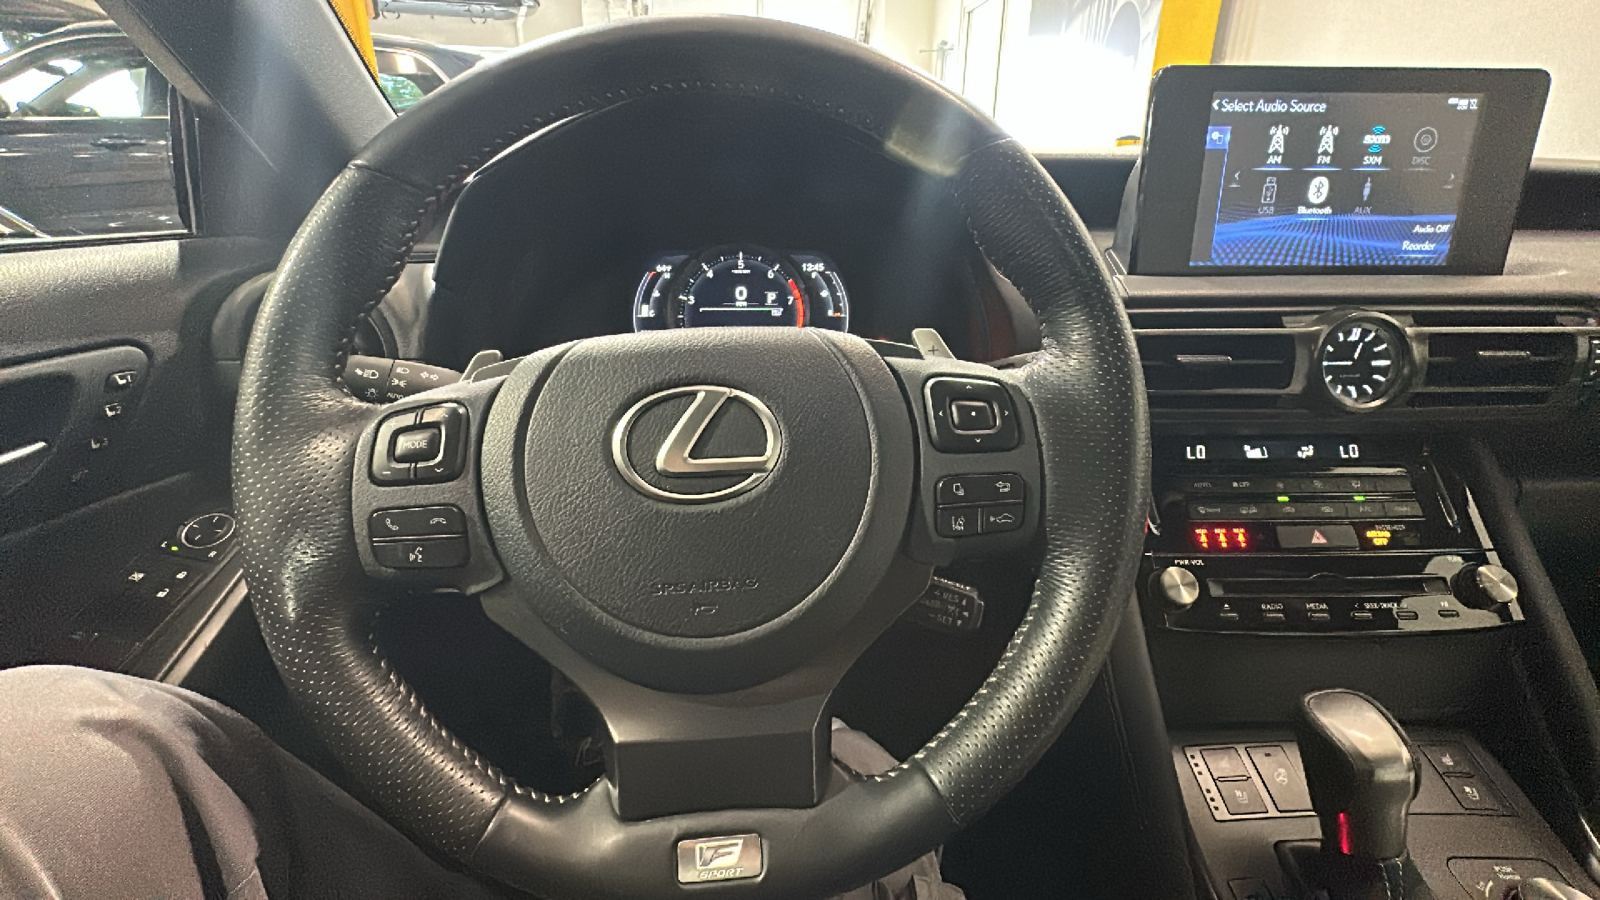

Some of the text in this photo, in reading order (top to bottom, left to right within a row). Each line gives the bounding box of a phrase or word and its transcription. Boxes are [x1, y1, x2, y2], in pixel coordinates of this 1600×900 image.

[1221, 99, 1327, 112] Select Audio Source
[1266, 155, 1282, 164] AM
[1317, 155, 1331, 164] FM
[1363, 155, 1382, 165] SXM
[1412, 156, 1431, 165] DISC
[1258, 206, 1274, 214] USB
[1297, 206, 1332, 214] Bluetooth
[1354, 206, 1372, 214] AUX
[1412, 224, 1434, 233] Audio
[1402, 240, 1436, 250] Reorder
[737, 259, 745, 269] 5
[802, 262, 825, 271] 12:45
[706, 269, 714, 279] 4
[767, 269, 775, 279] 6
[687, 295, 696, 305] 3
[787, 296, 795, 306] 7
[403, 440, 428, 449] MODE
[1305, 602, 1329, 610] MEDIA
[699, 867, 744, 879] SPORT
